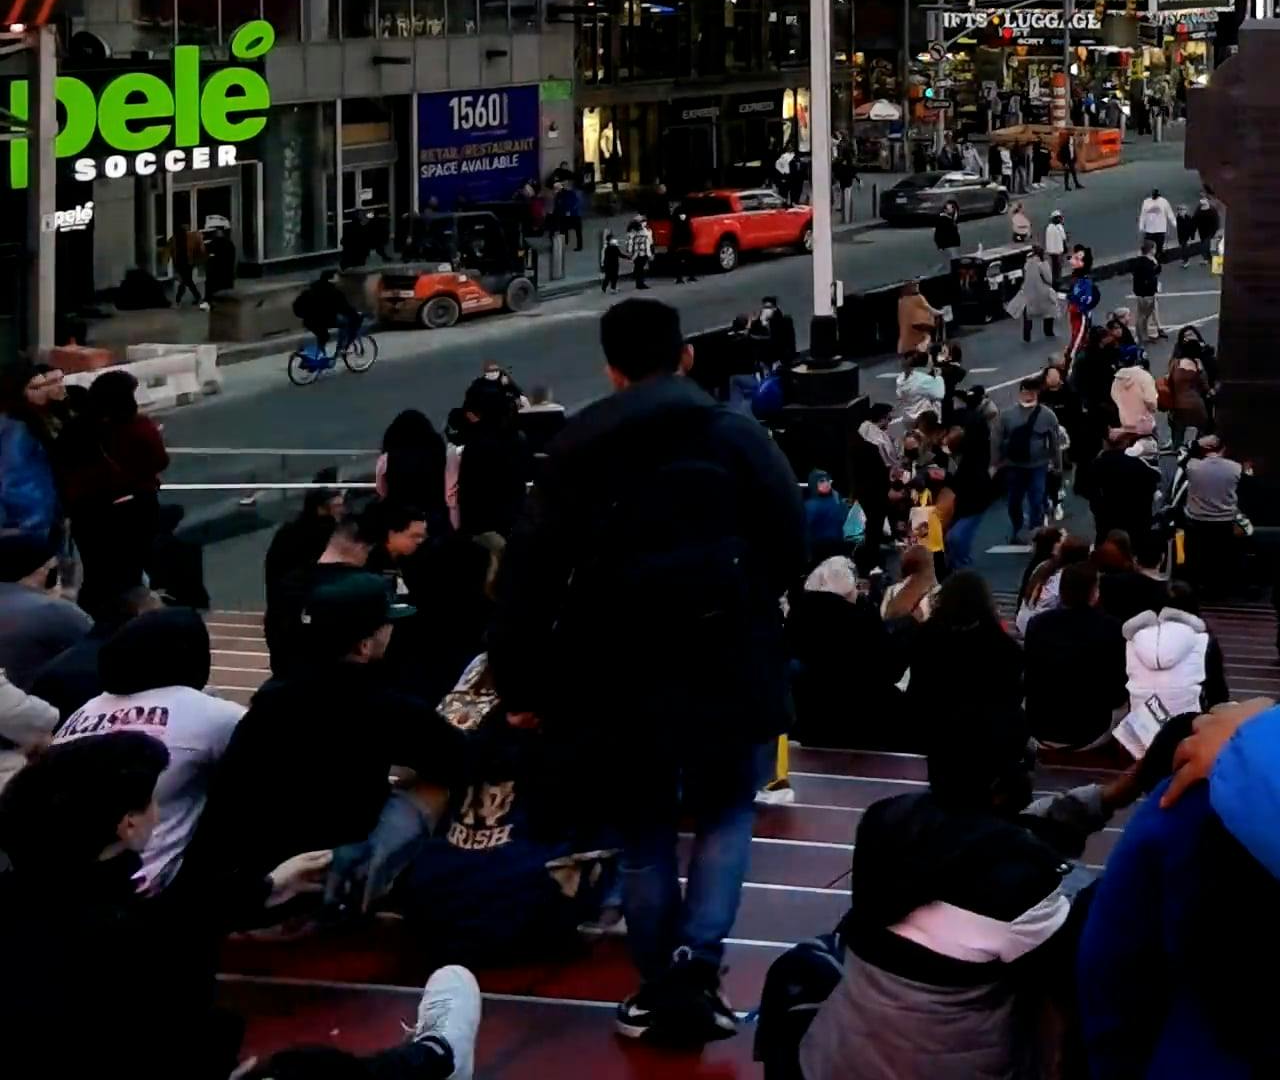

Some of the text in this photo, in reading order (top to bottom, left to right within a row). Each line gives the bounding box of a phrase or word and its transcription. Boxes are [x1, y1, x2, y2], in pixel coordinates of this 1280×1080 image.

[943, 12, 1101, 28] IFTS LUGGAGE
[449, 93, 500, 130] 1560
[75, 145, 237, 181] SOCCER
[420, 154, 519, 178] SPACE AVAILABLE
